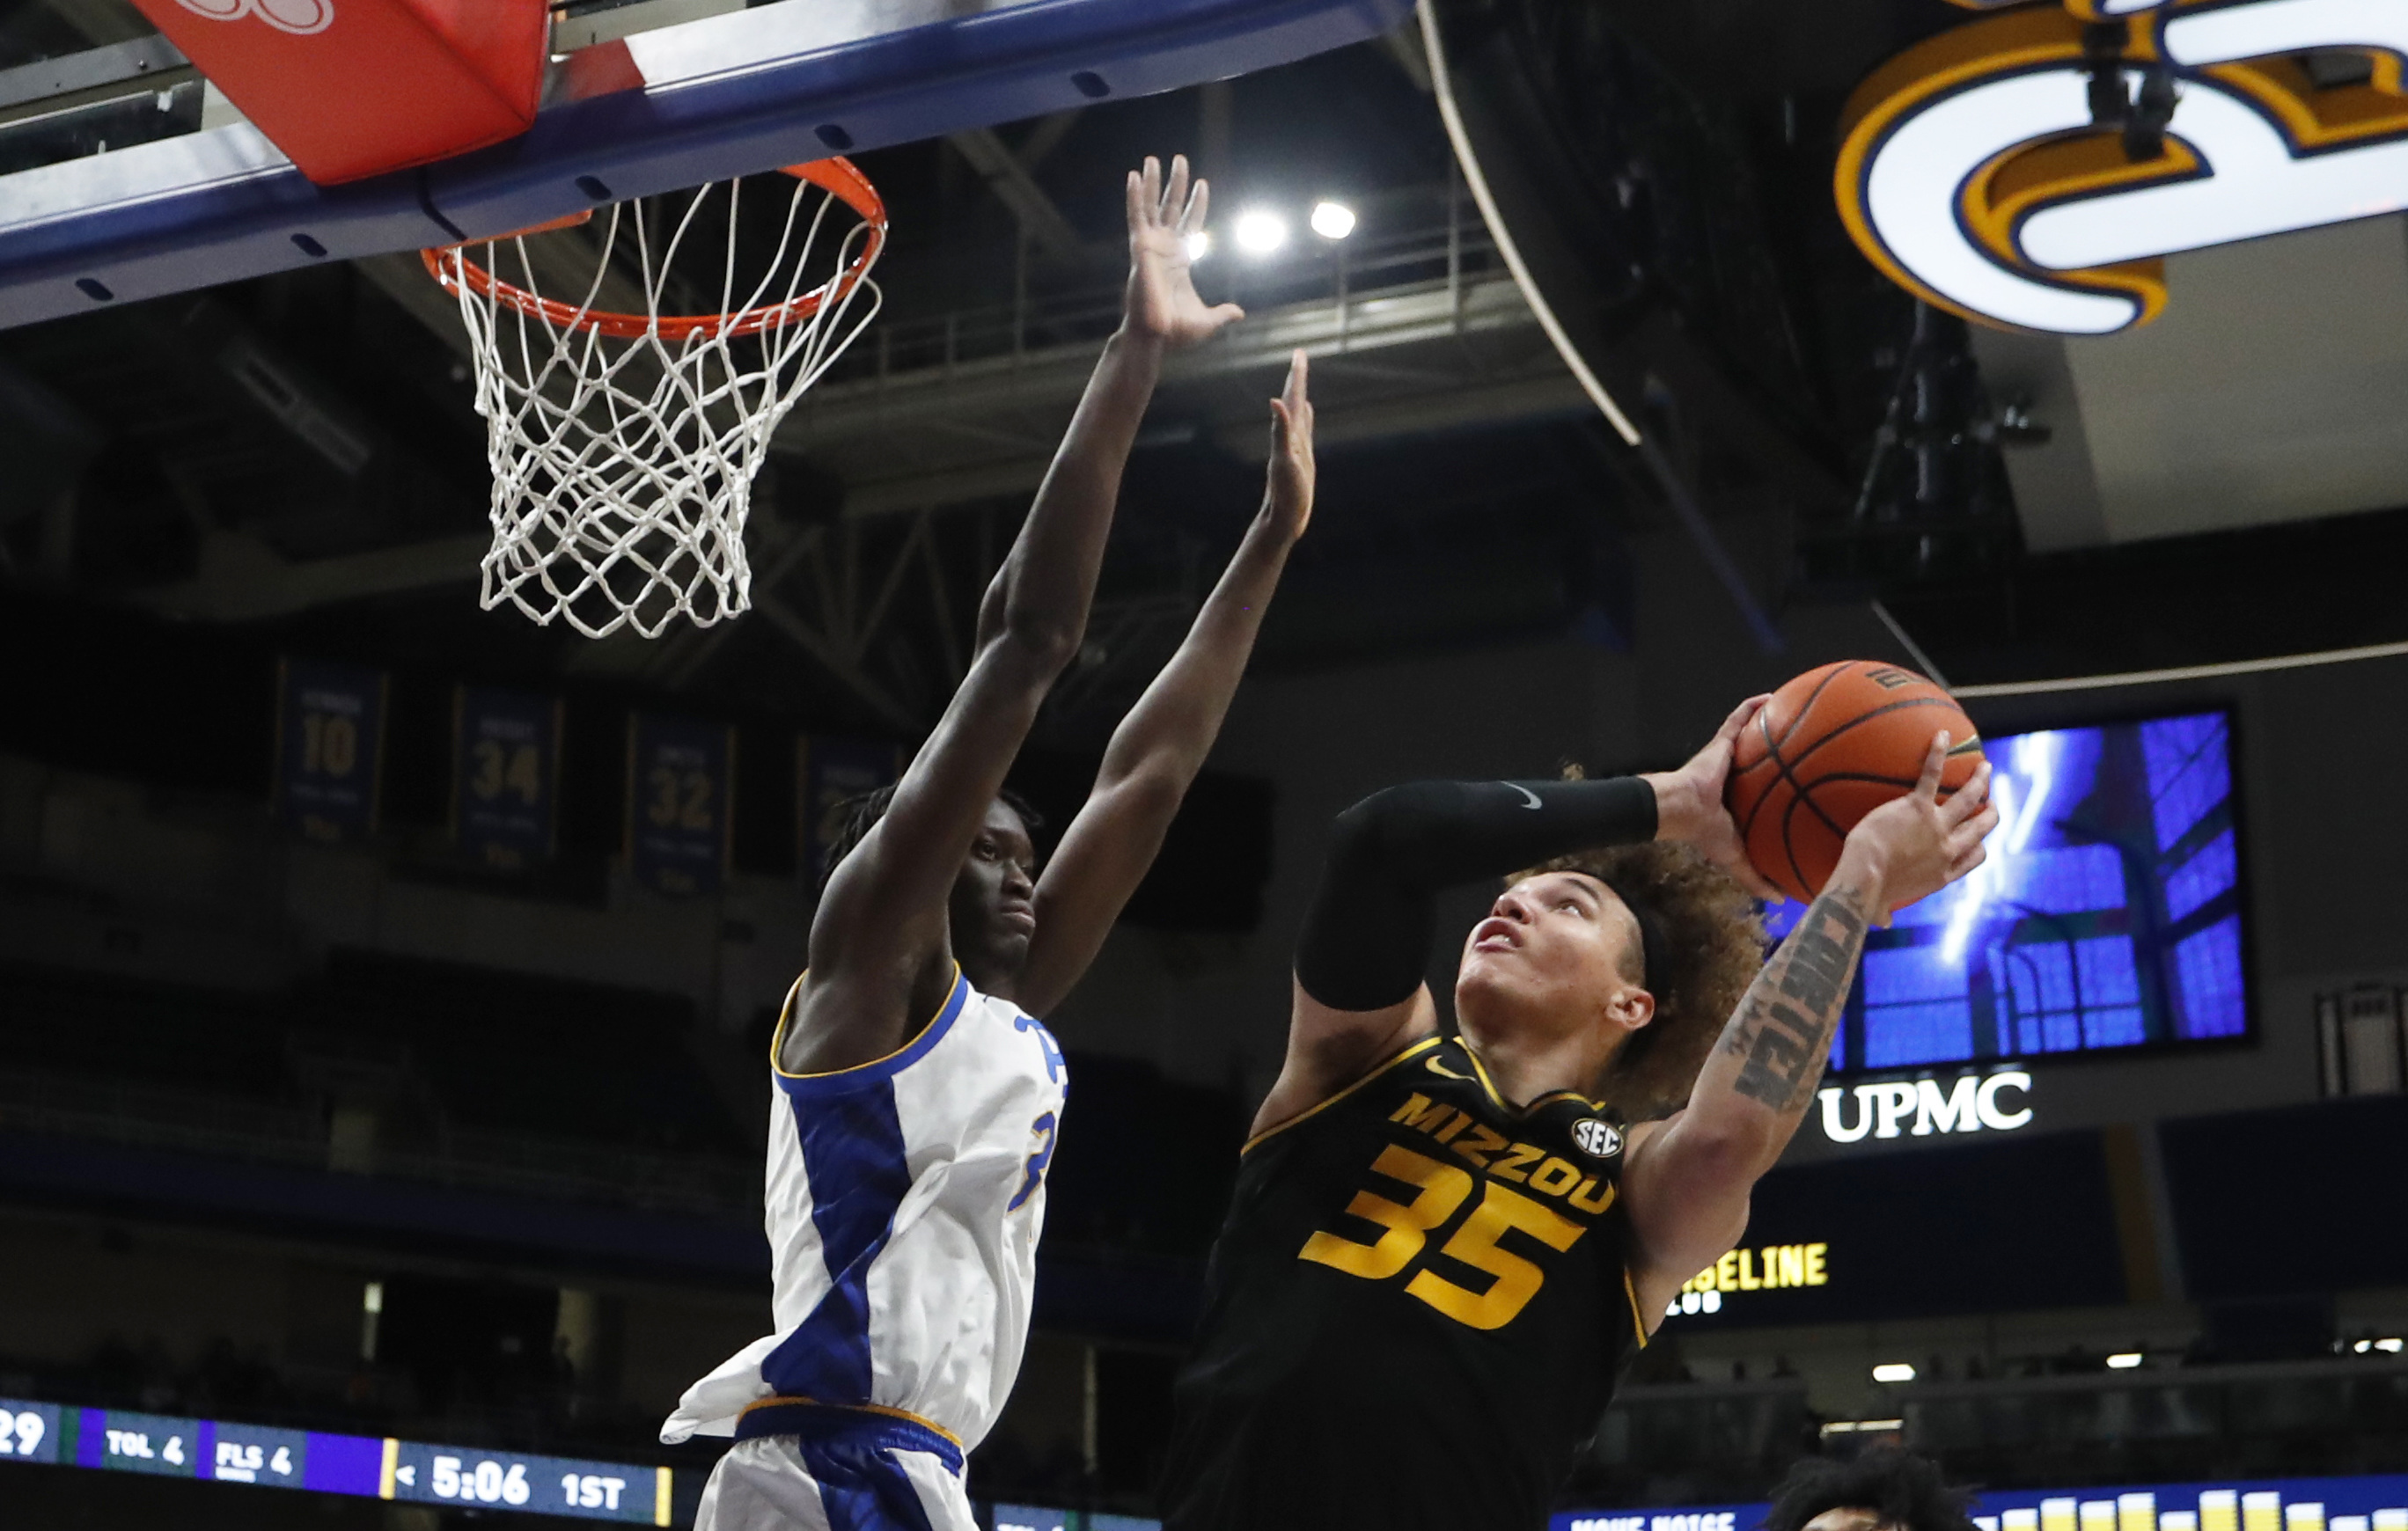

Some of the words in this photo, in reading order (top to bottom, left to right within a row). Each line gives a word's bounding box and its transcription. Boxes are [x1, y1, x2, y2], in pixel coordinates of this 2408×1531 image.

[302, 711, 358, 780] 10
[1575, 1120, 1619, 1155] SEC
[1817, 1071, 2034, 1143] UPMC
[1388, 1092, 1617, 1214] MIZZOU
[1296, 1143, 1588, 1330] 35
[1682, 1242, 1829, 1294] SELINE
[106, 1429, 155, 1459] TOL
[162, 1435, 186, 1466] 4
[216, 1441, 264, 1470] FLS
[269, 1446, 294, 1476] 4
[431, 1454, 531, 1505] 5:06
[561, 1472, 627, 1511] 1ST
